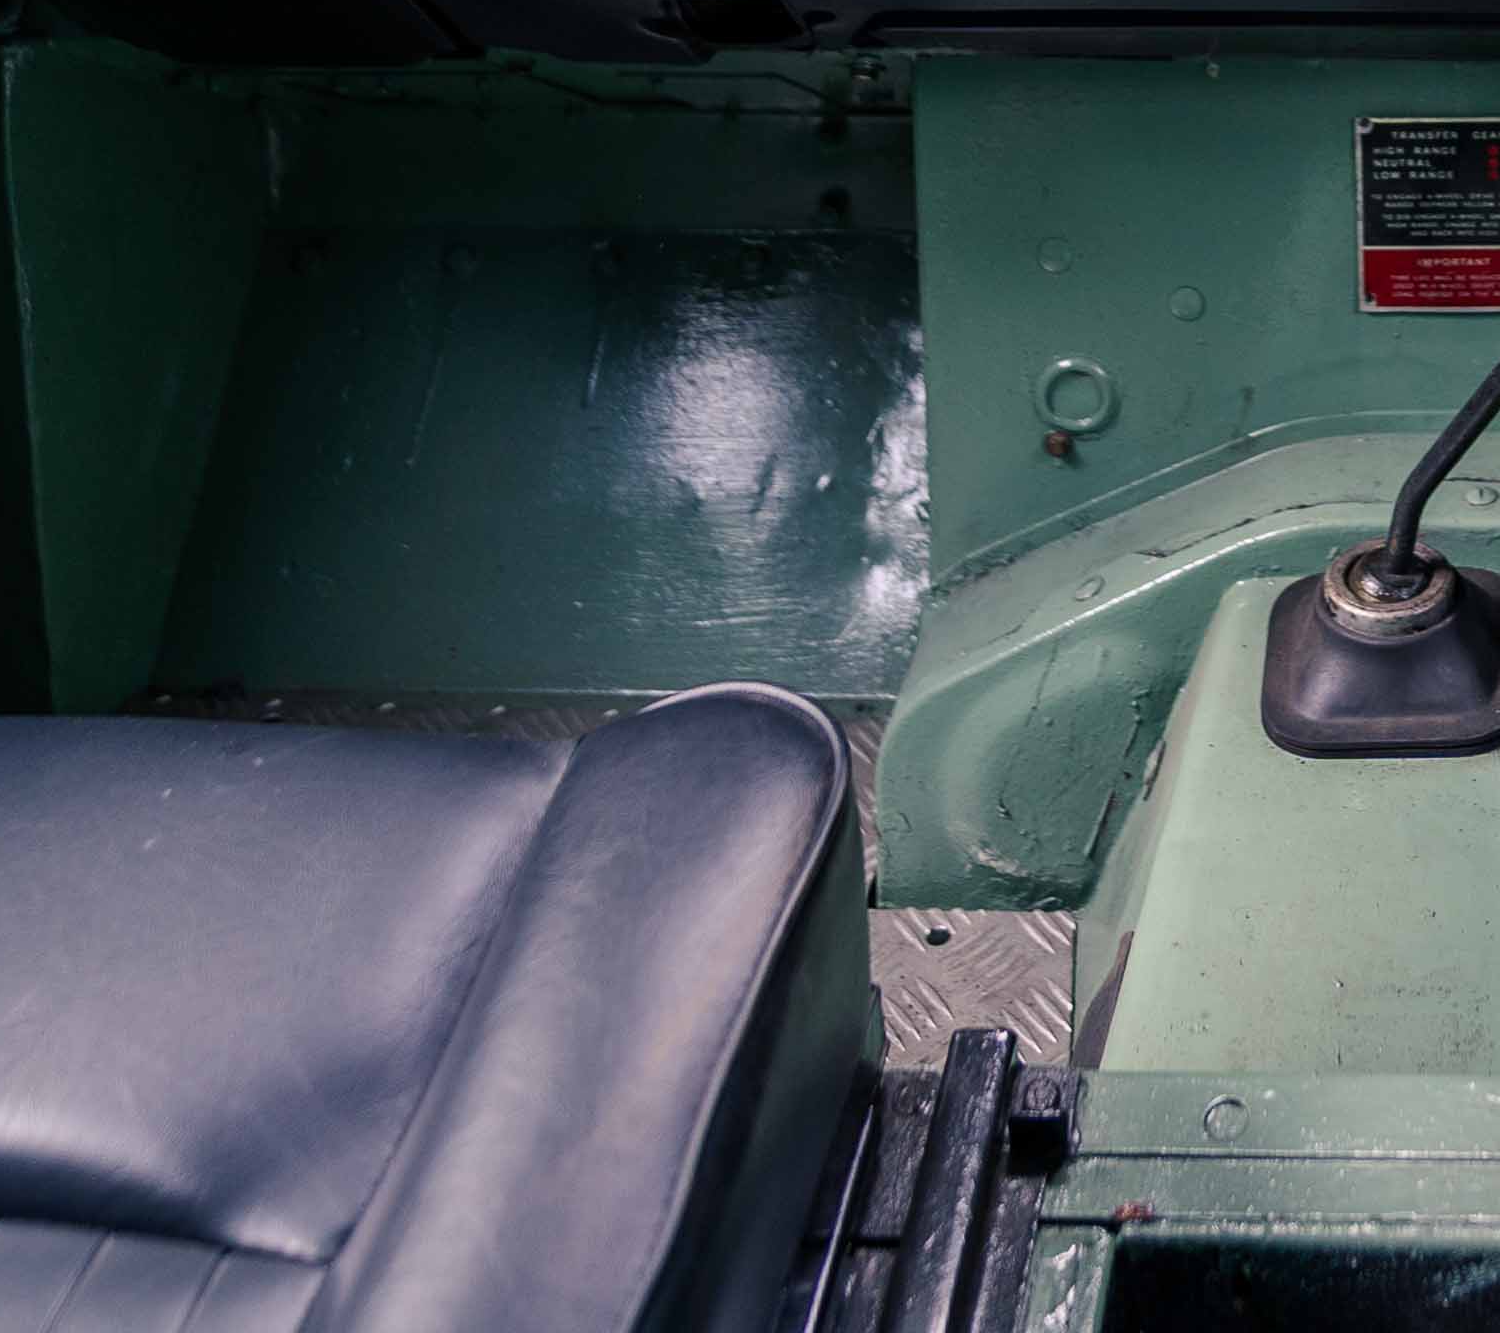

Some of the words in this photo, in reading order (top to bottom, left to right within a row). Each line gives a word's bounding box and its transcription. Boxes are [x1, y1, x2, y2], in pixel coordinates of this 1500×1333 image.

[1392, 131, 1459, 140] TRANSFER
[1372, 146, 1404, 155] HIGH
[1413, 146, 1457, 155] RANGE
[1372, 159, 1432, 168] NEUTRAL
[1372, 171, 1400, 180] LOW
[1409, 171, 1454, 180] RANGE
[1417, 258, 1491, 267] IMPORTANT
